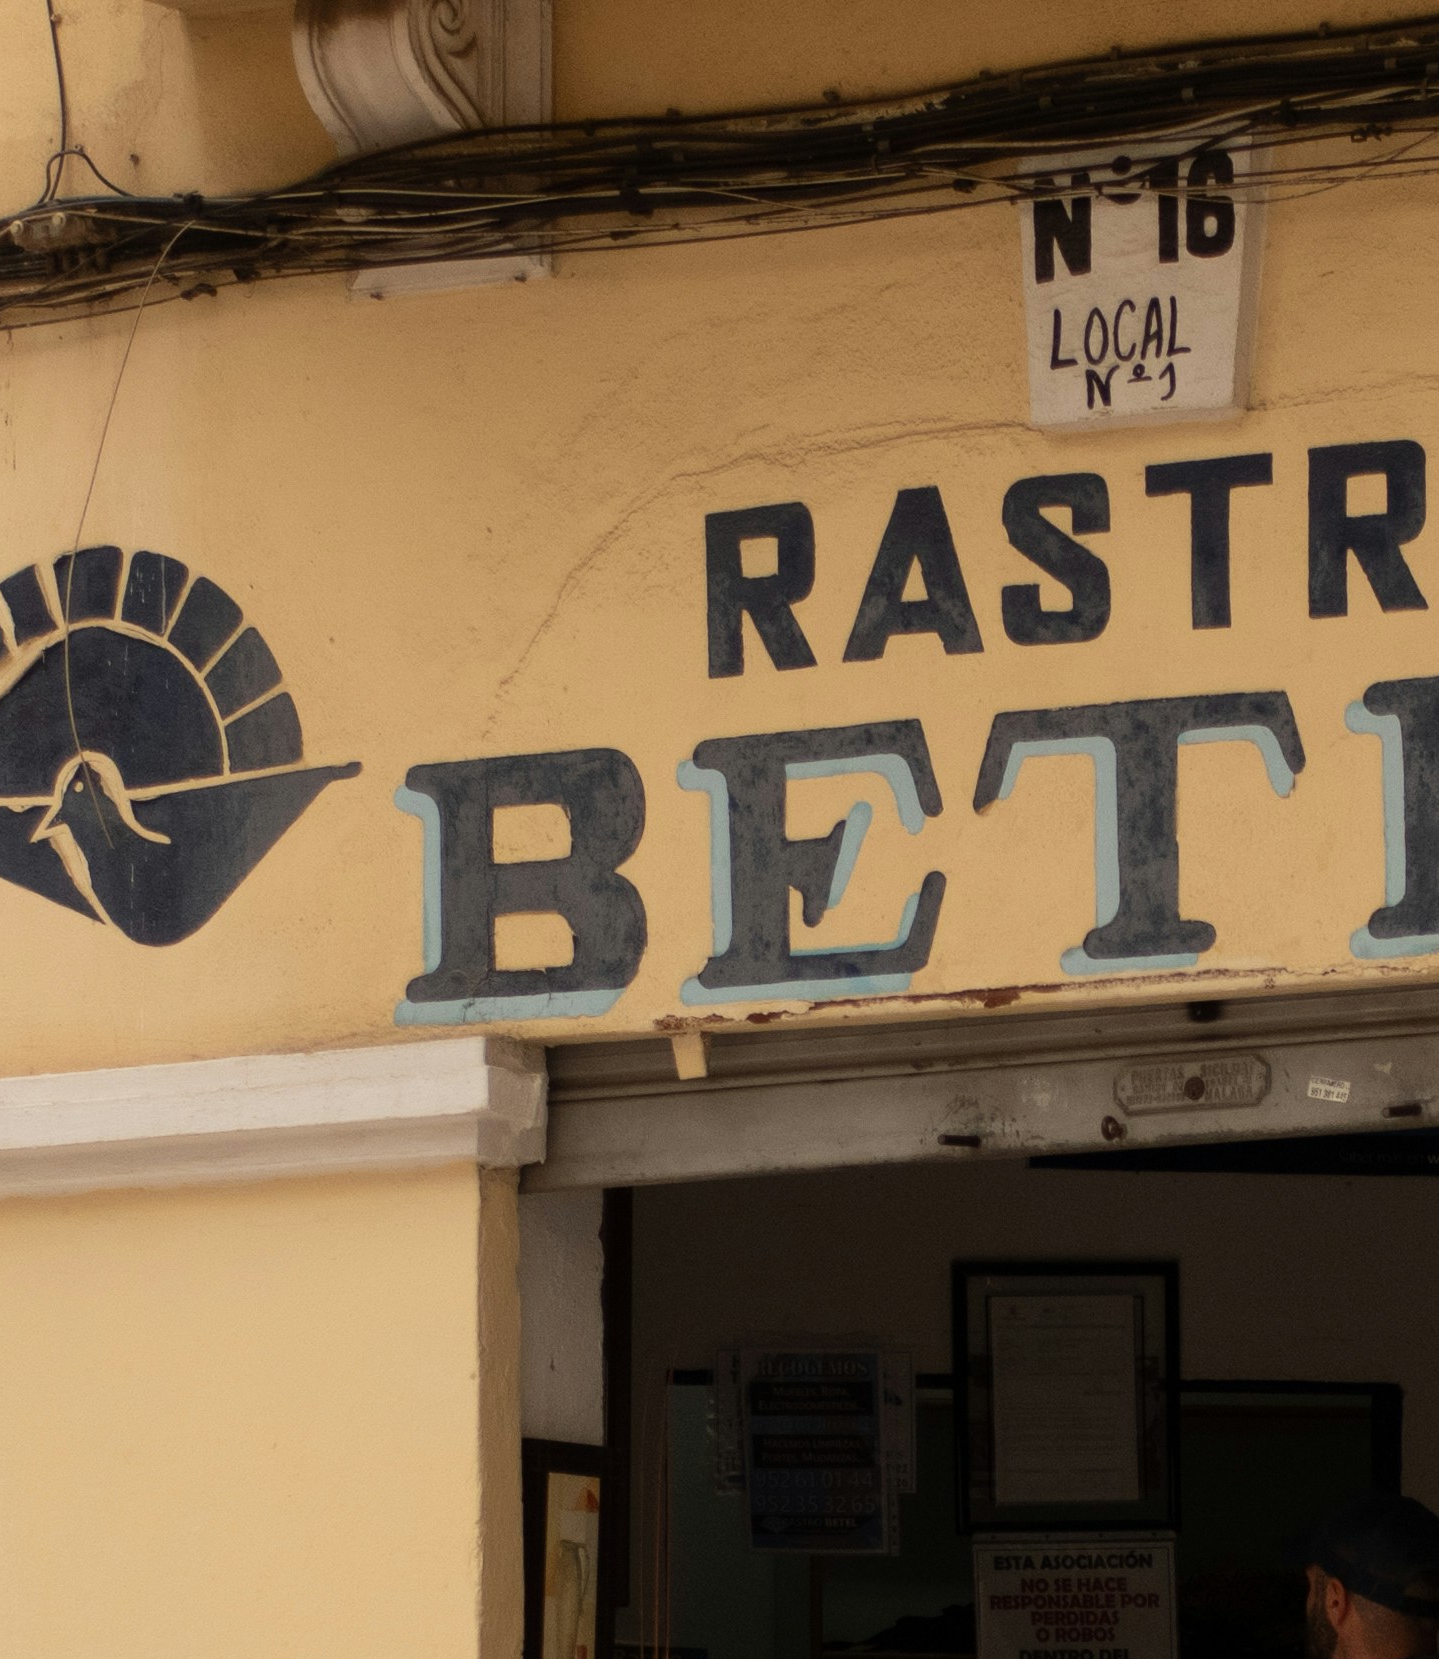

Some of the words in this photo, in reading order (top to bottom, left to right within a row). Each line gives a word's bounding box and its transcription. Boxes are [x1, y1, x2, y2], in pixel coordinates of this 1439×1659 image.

[1149, 151, 1235, 263] 16
[1050, 296, 1191, 370] LOCAL
[755, 1470, 790, 1488] 952
[794, 1470, 816, 1488] 61
[821, 1470, 843, 1488] 01
[849, 1470, 873, 1488] 44
[754, 1495, 790, 1513] 952
[797, 1495, 819, 1513] 35
[823, 1495, 847, 1513] 32
[851, 1495, 876, 1513] 65
[993, 1555, 1036, 1571] ESTA
[1040, 1550, 1153, 1570] ASOCIACIÓN
[1020, 1578, 1049, 1593] NO
[1054, 1578, 1072, 1592] SE
[1077, 1577, 1127, 1592] HACE
[990, 1594, 1116, 1610] RESPONSABLE
[1120, 1593, 1160, 1608] POR
[1031, 1610, 1120, 1626] PERDIDAS
[1035, 1628, 1050, 1643] O
[1055, 1627, 1116, 1642] ROBOS
